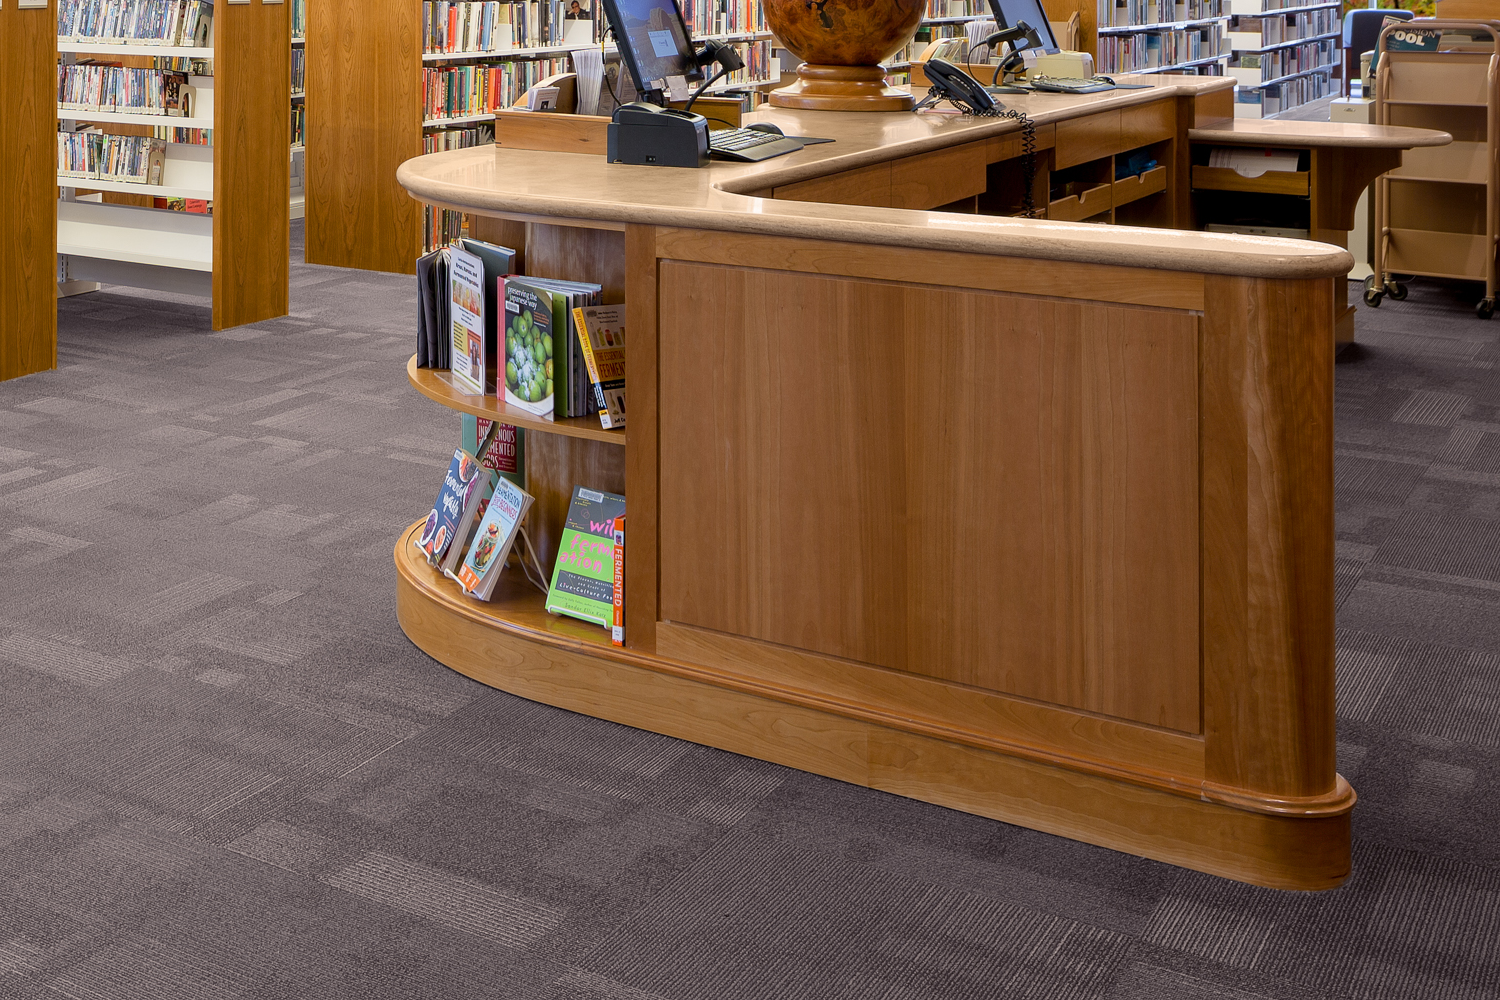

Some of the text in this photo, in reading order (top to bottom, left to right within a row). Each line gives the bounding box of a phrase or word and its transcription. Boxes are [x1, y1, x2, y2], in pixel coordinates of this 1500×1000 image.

[507, 286, 530, 301] preserving
[528, 299, 538, 310] way
[598, 361, 625, 378] FERMENT
[478, 425, 515, 443] INNOUS
[589, 519, 615, 537] wil
[570, 533, 615, 560] ferm
[559, 551, 603, 574] ation
[614, 548, 623, 607] FERMENTED
